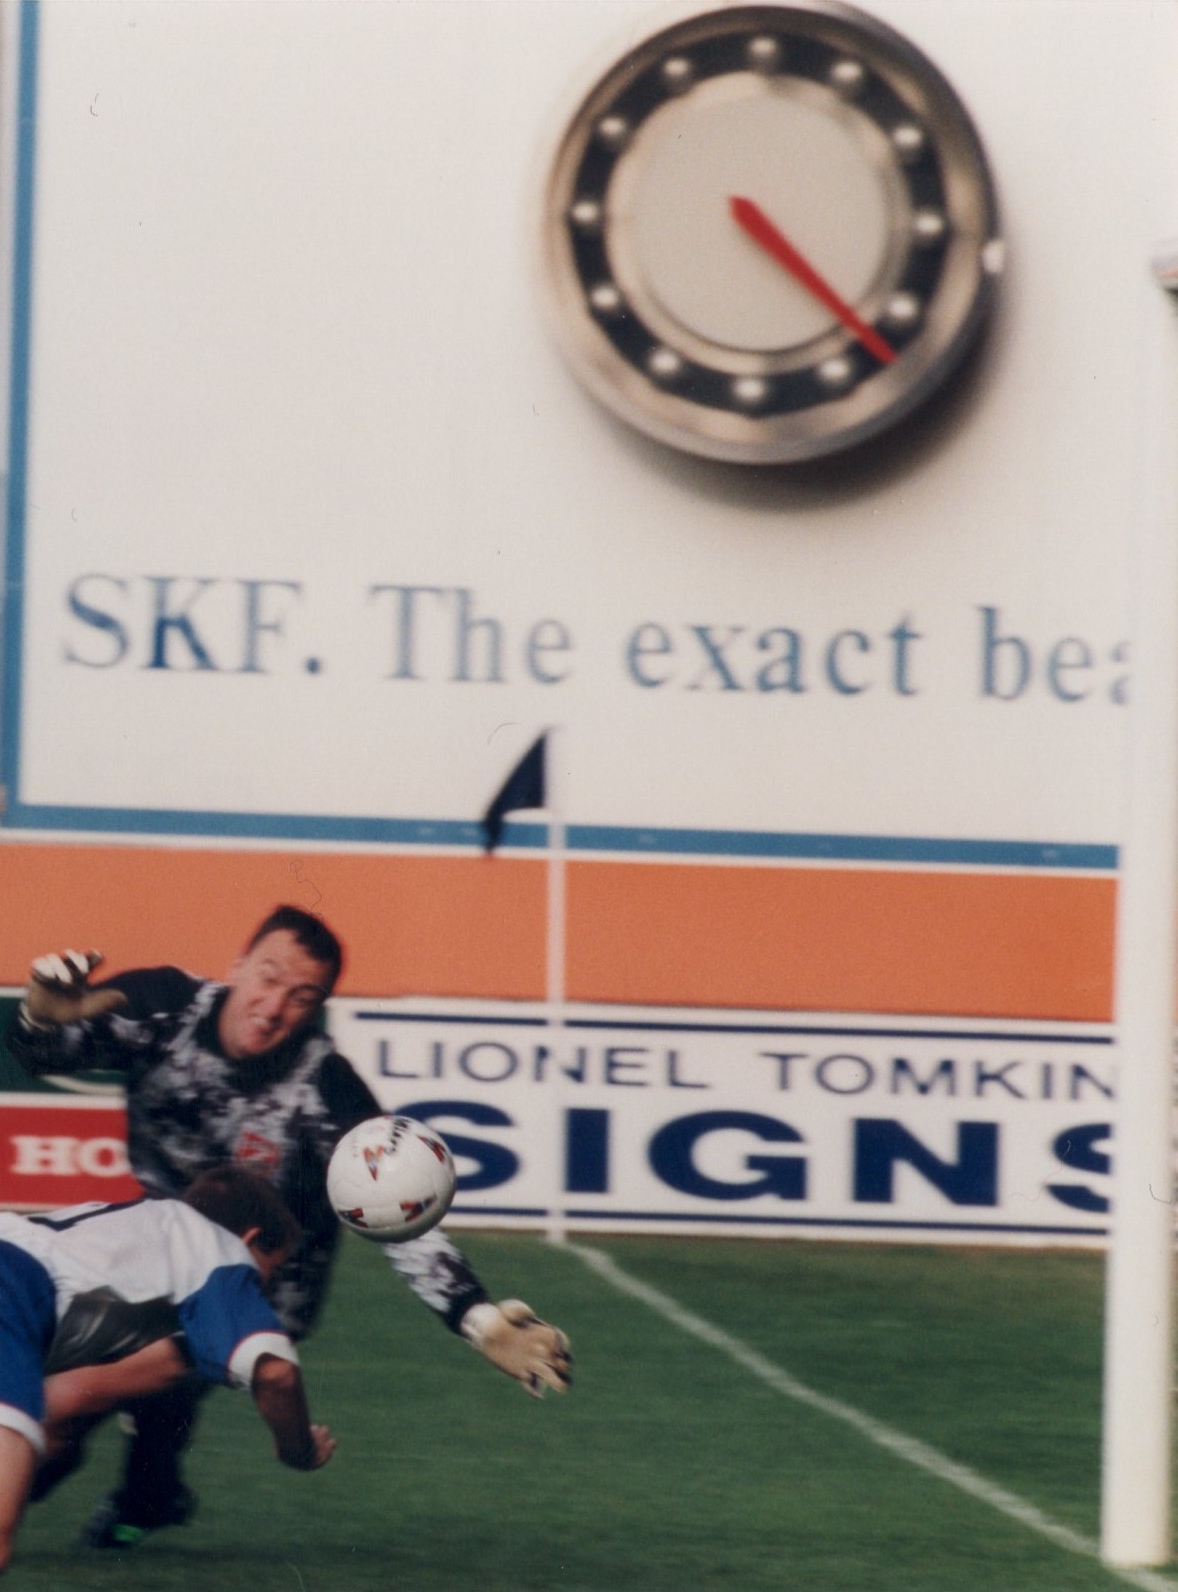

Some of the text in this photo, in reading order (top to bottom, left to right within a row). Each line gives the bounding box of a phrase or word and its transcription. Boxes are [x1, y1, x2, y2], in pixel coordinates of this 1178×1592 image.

[61, 572, 325, 676] SKF.
[370, 583, 572, 684] The
[625, 612, 926, 697] exact
[377, 1039, 710, 1090] LIONEL
